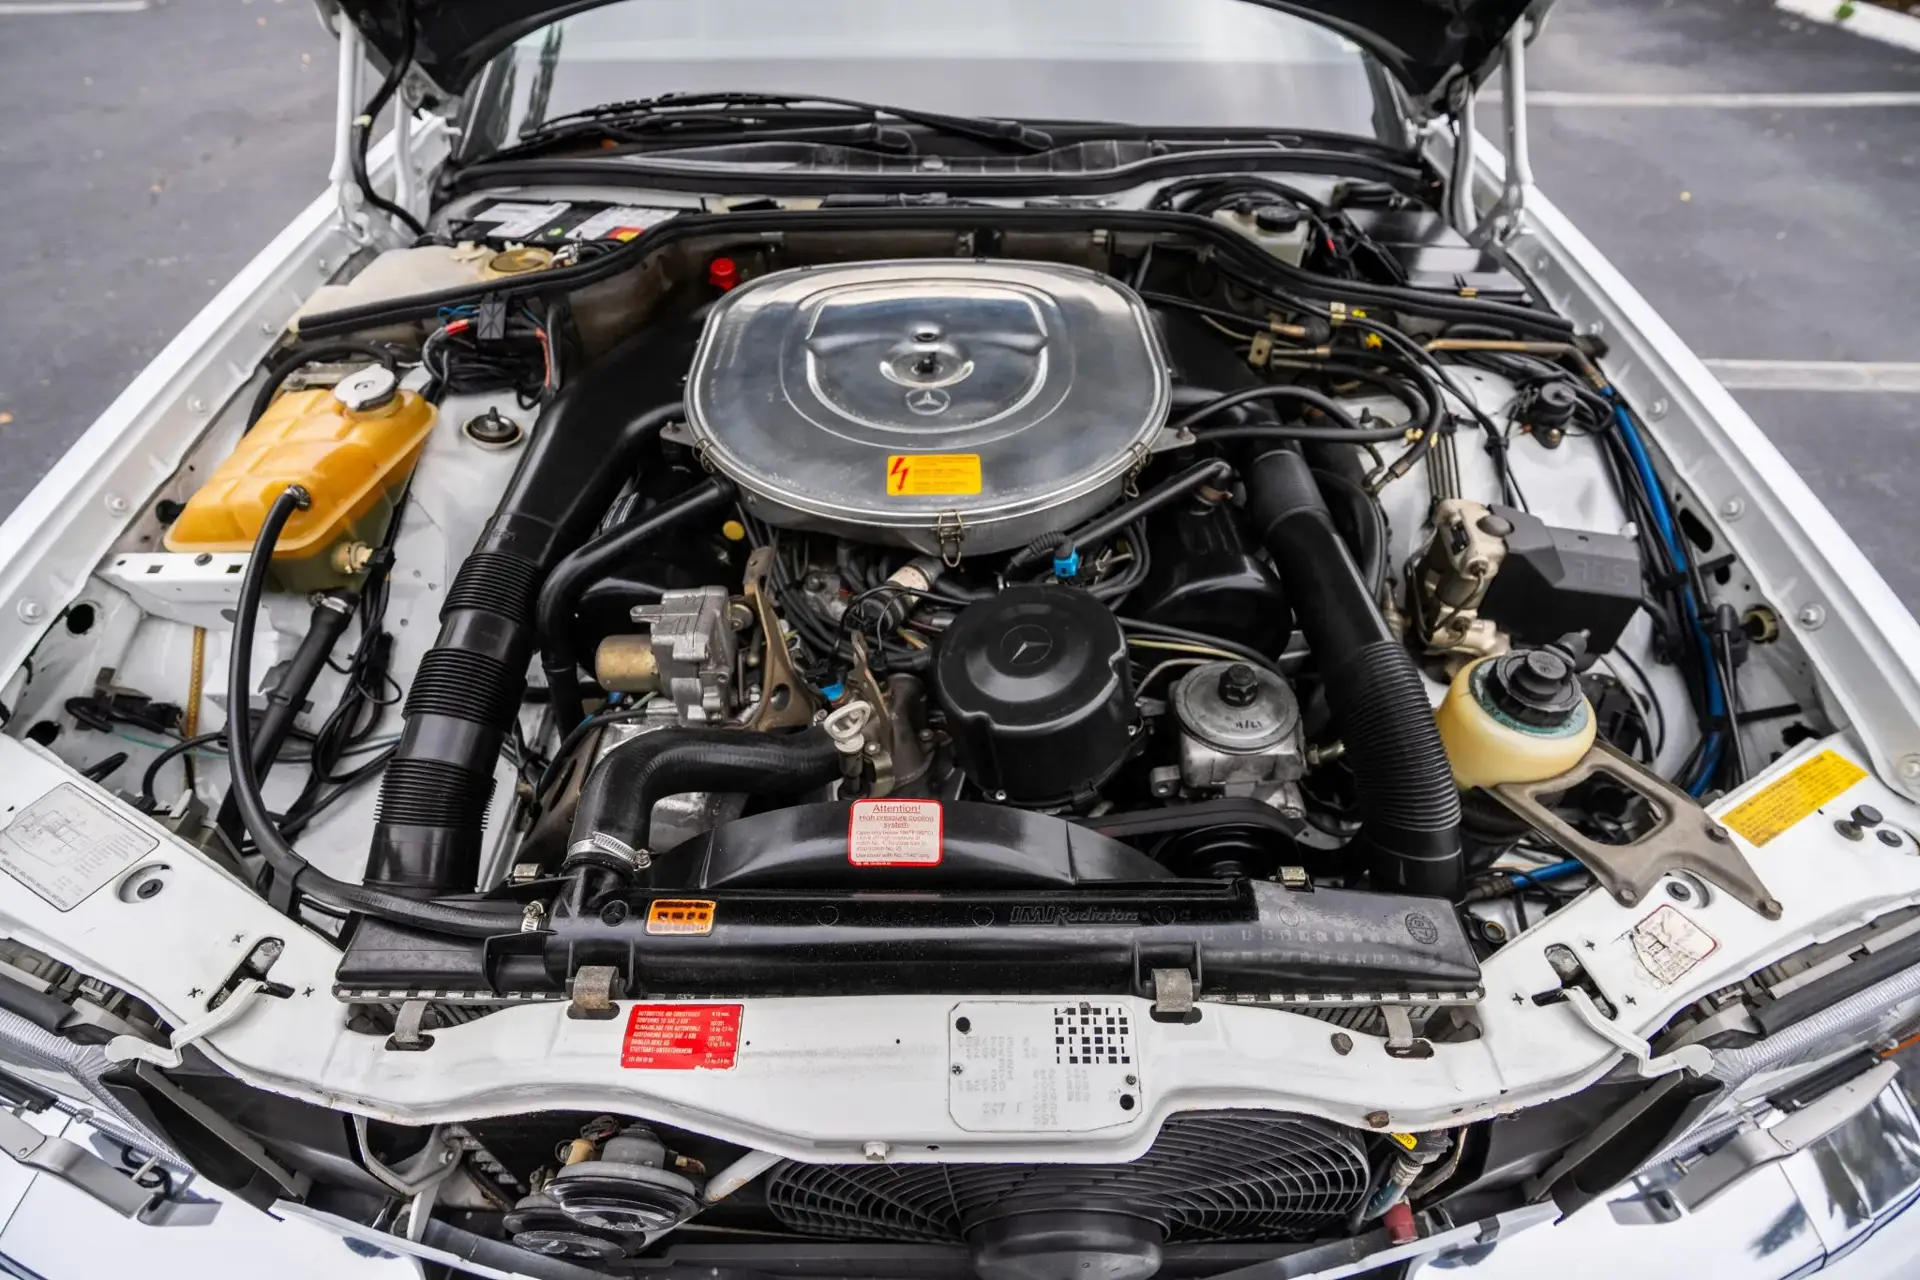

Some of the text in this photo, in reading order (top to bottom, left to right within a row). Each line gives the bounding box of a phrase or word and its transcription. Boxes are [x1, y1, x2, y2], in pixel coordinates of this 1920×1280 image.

[872, 804, 921, 813] Attention!
[908, 815, 935, 823] cooling
[1009, 905, 1139, 926] IMI Radiators
